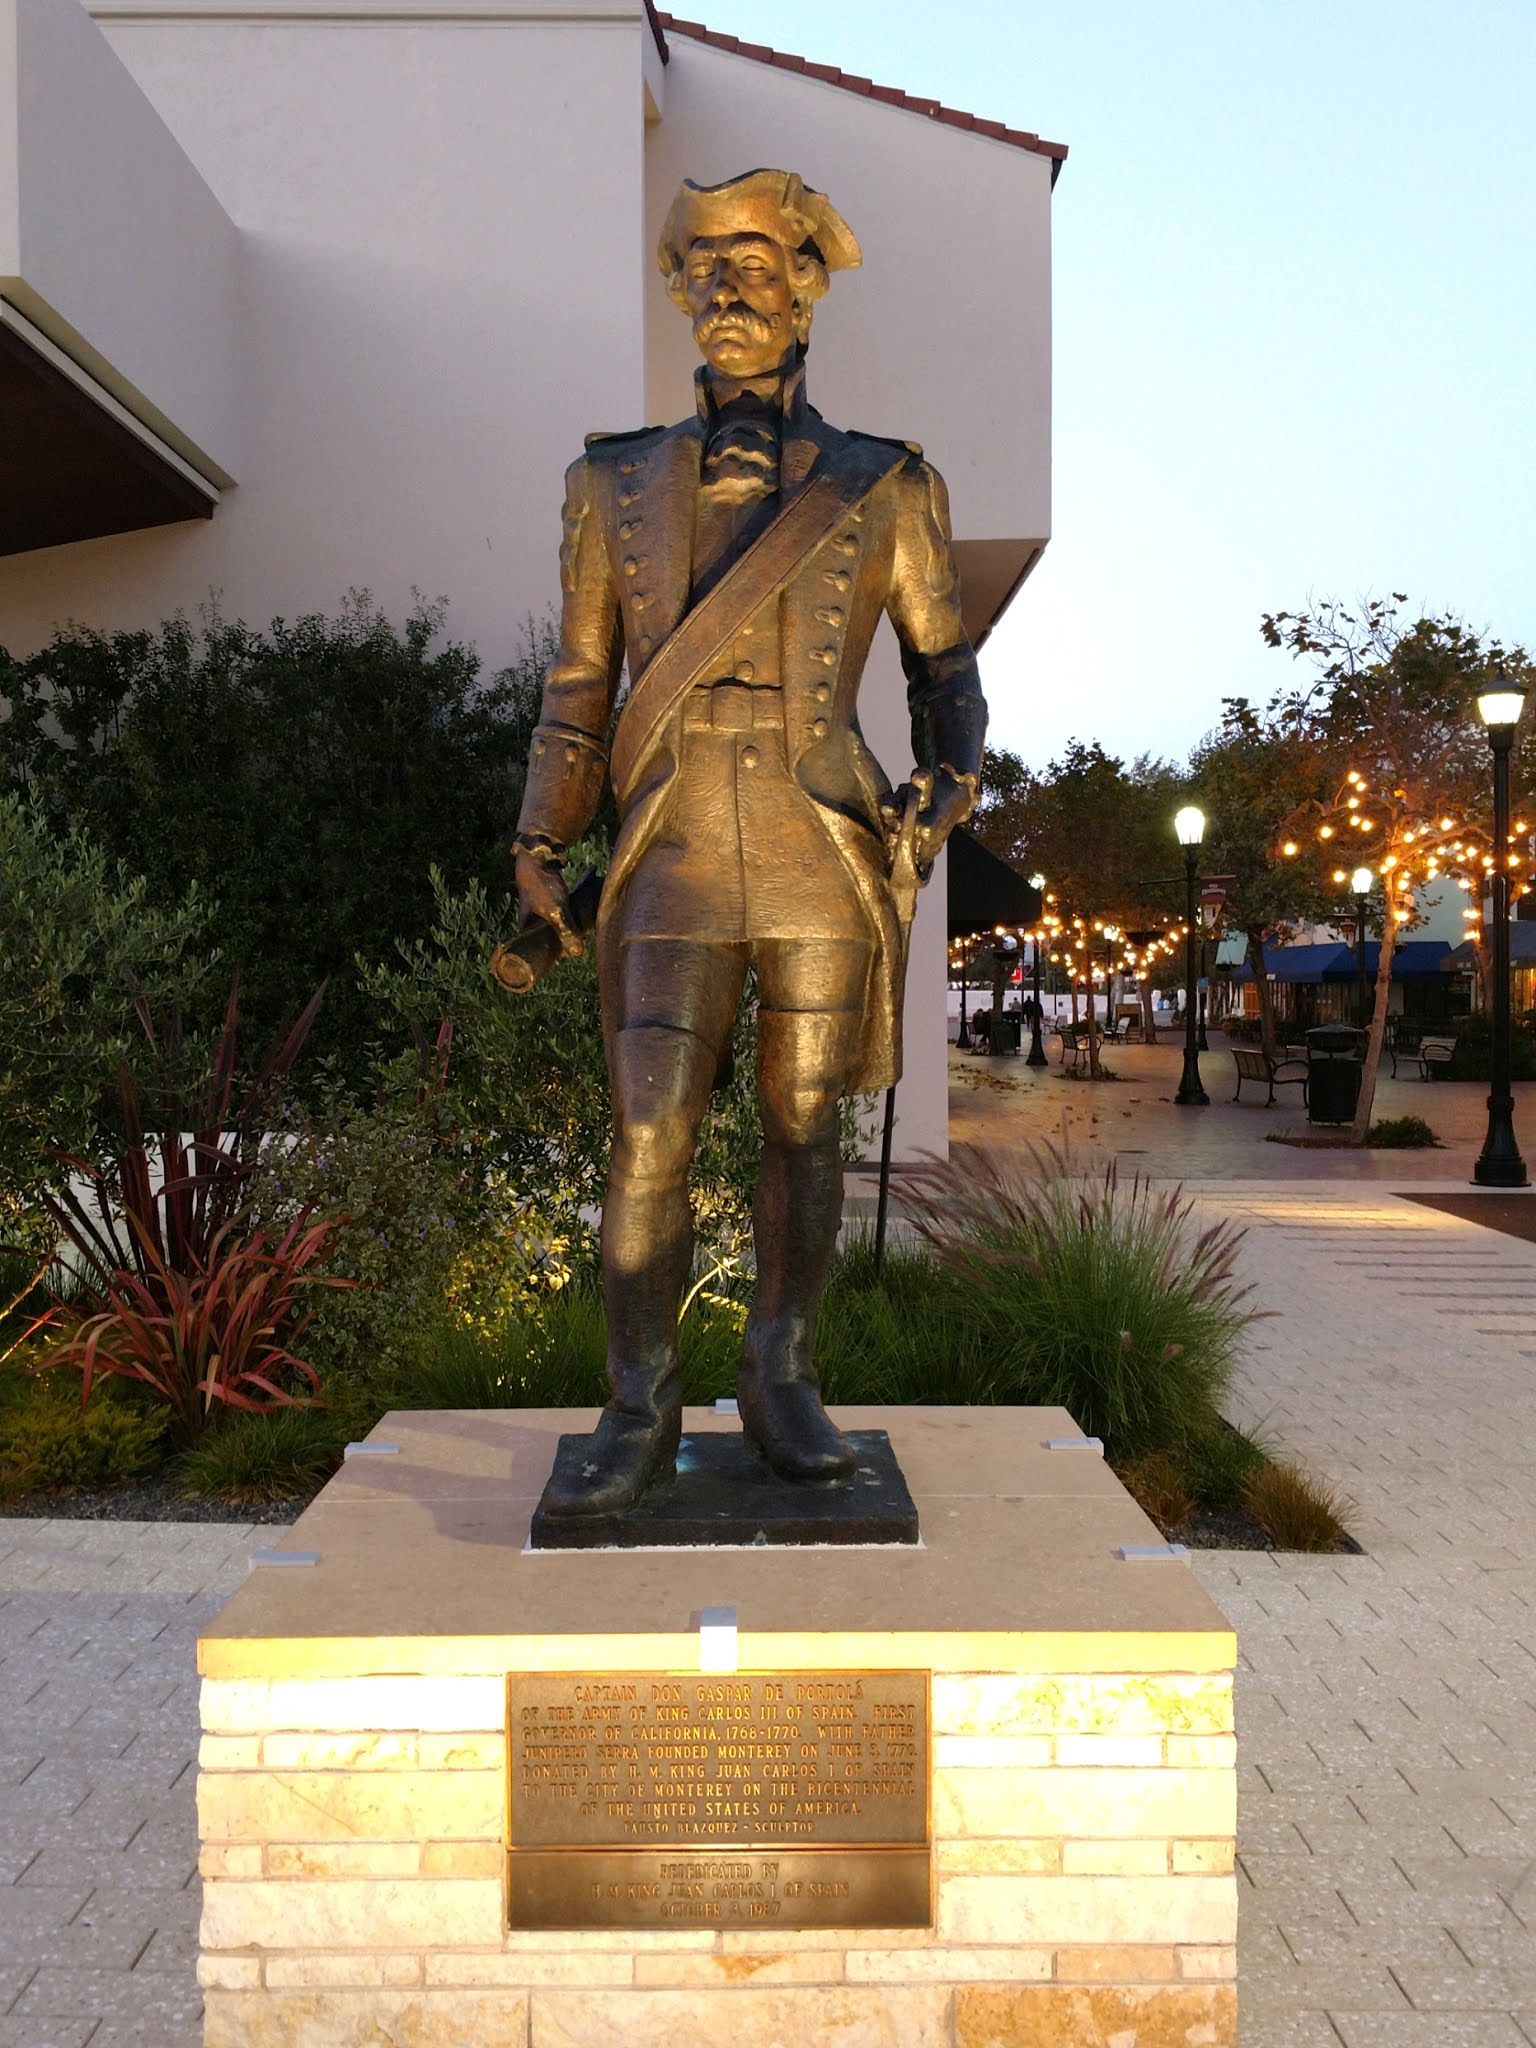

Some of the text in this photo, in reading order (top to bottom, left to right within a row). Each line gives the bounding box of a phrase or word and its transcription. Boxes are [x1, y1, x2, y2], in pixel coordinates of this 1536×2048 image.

[574, 1679, 864, 1701] CAPTAIN DON GASPAR DE PORTOLÁ
[521, 1706, 539, 1721] OF
[548, 1706, 574, 1721] THE
[582, 1706, 621, 1721] ARMY
[630, 1706, 647, 1720] OF
[656, 1706, 689, 1720] KING
[698, 1705, 751, 1720] CARLOS
[786, 1705, 804, 1720] OF
[873, 1704, 915, 1719] FIRST
[522, 1726, 596, 1740] GOVERNOR
[605, 1725, 622, 1740] OF
[631, 1725, 721, 1741] CALIFORNIA,
[817, 1724, 852, 1738] WITH
[862, 1724, 915, 1738] FATHER
[522, 1744, 587, 1760] JUNIPERO
[597, 1744, 639, 1759] SERRA
[648, 1744, 708, 1759] FOUNDED
[718, 1743, 791, 1759] MONTEREY
[801, 1743, 818, 1758] ON
[827, 1743, 861, 1757] JUNE
[522, 1763, 589, 1779] DONATED
[600, 1763, 618, 1778] BY
[670, 1763, 705, 1778] KING
[716, 1763, 751, 1778] JUAN
[763, 1763, 818, 1778] CARLOS
[845, 1763, 863, 1776] OF
[873, 1762, 915, 1776] SPAIN
[521, 1781, 915, 1798] TO THE CITY OF MONTEREY ON THE BICENTENNIAL
[581, 1802, 598, 1817] OF
[607, 1802, 634, 1816] THE
[643, 1802, 696, 1817] UNITED
[705, 1801, 760, 1816] STATES
[769, 1801, 786, 1815] OF
[624, 1821, 669, 1834] FAUSTO
[677, 1821, 738, 1834] BLAZQUEZ
[755, 1821, 815, 1833] SCULPTOR
[660, 1862, 780, 1880] REDEDICATED BY
[627, 1882, 661, 1898] KING
[668, 1882, 704, 1898] JUAN
[713, 1882, 764, 1898] CARLOS
[783, 1882, 803, 1898] OF
[807, 1882, 849, 1898] SPAIN
[661, 1902, 720, 1918] OCTOBER
[748, 1901, 781, 1918] 1987
